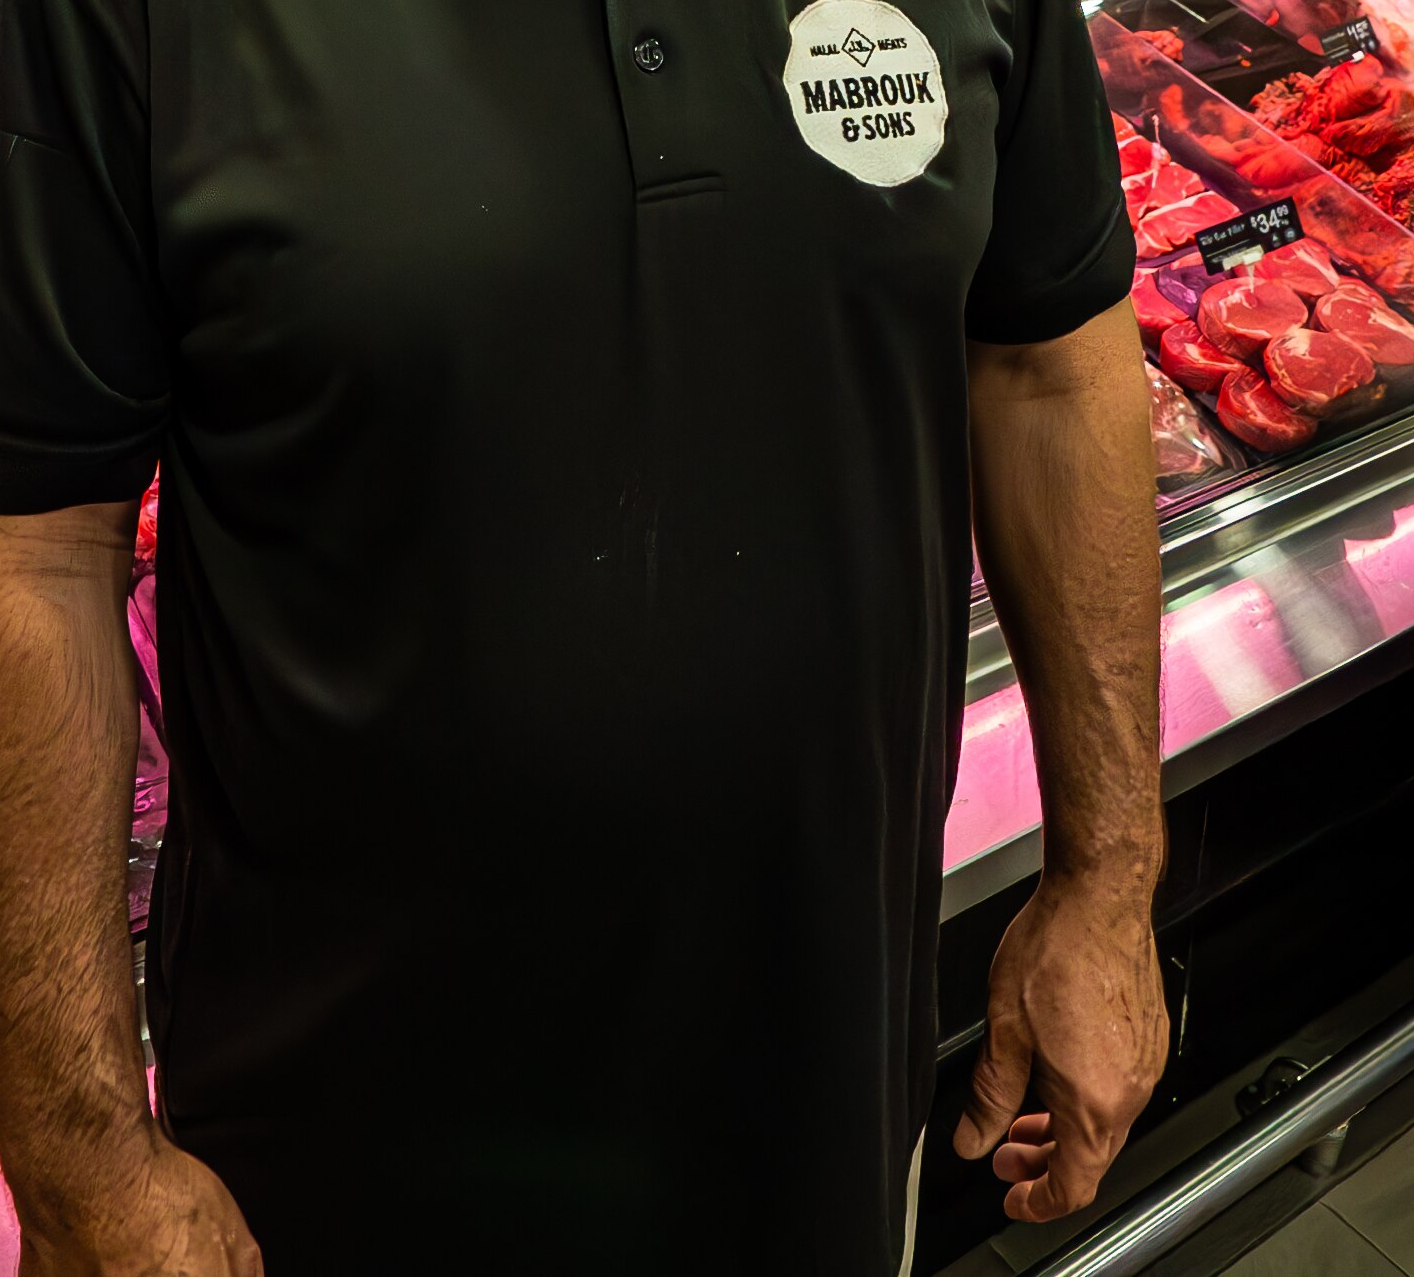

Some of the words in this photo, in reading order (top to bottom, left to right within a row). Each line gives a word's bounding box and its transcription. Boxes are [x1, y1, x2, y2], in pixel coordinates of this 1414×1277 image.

[800, 72, 935, 114] MABROUK
[841, 116, 861, 142] &
[862, 112, 915, 141] SONS
